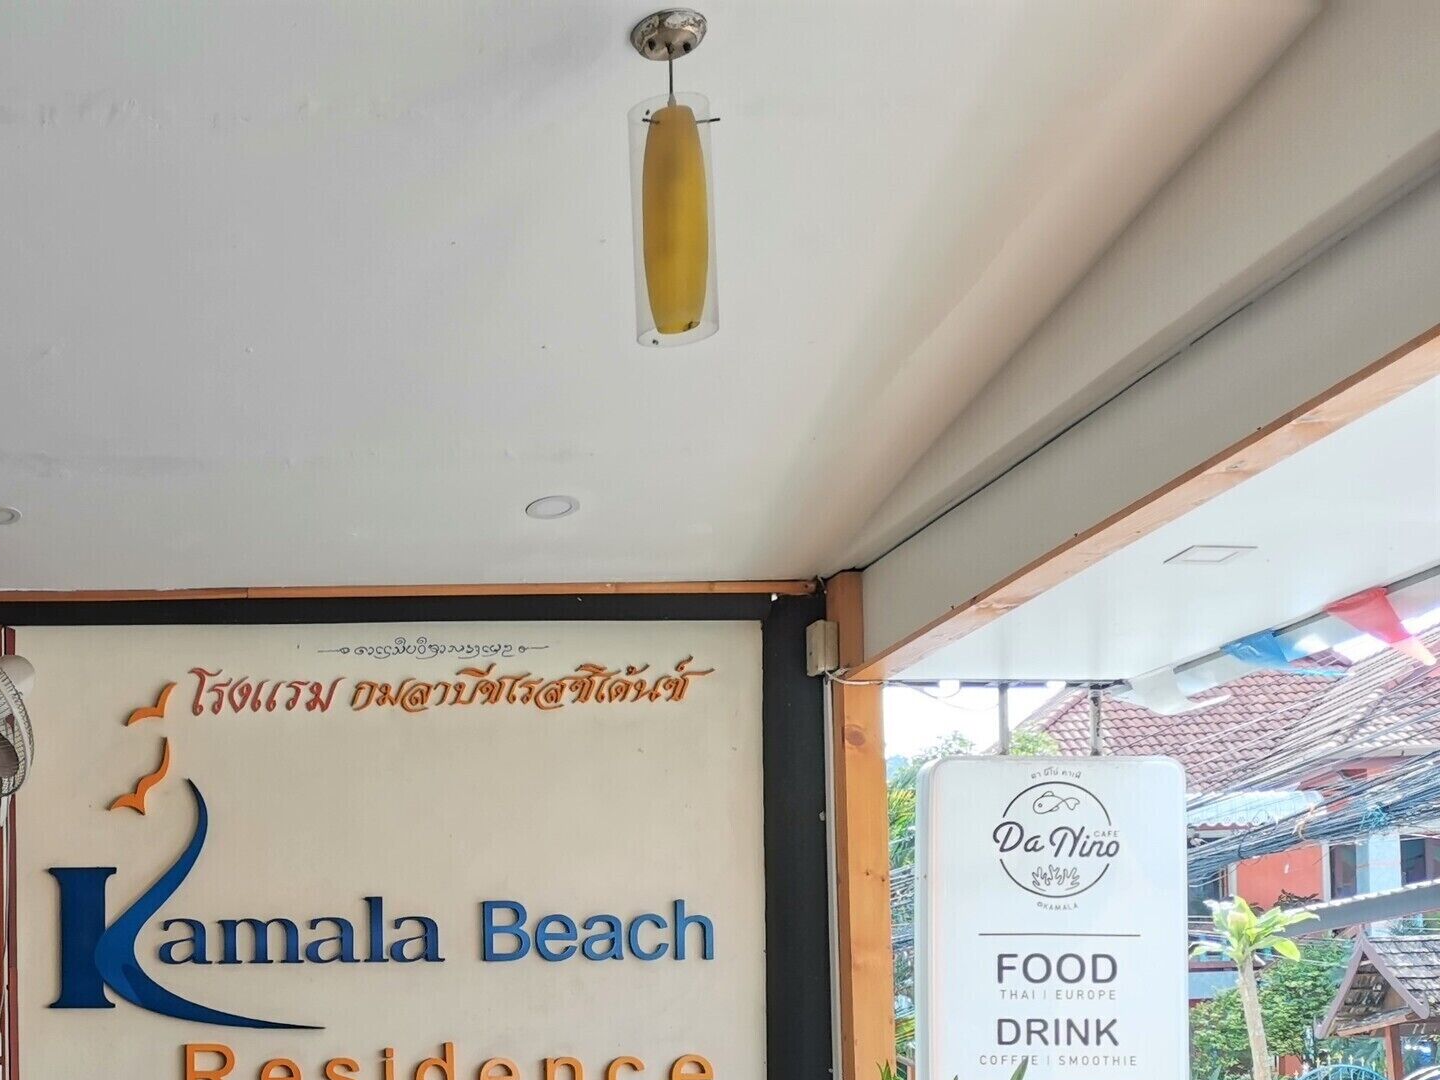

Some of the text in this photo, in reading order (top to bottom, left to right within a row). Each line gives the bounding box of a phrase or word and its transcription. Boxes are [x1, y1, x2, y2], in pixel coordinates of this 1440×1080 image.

[188, 667, 346, 716] โรงแรม
[993, 821, 1120, 858] Da Nino
[49, 779, 715, 1030] Kamala Beach
[997, 953, 1118, 984] FOOD
[1000, 989, 1116, 1000] THAI EUROPE
[997, 1018, 1119, 1046] DRINK
[1058, 1055, 1137, 1066] SMOOTHIE
